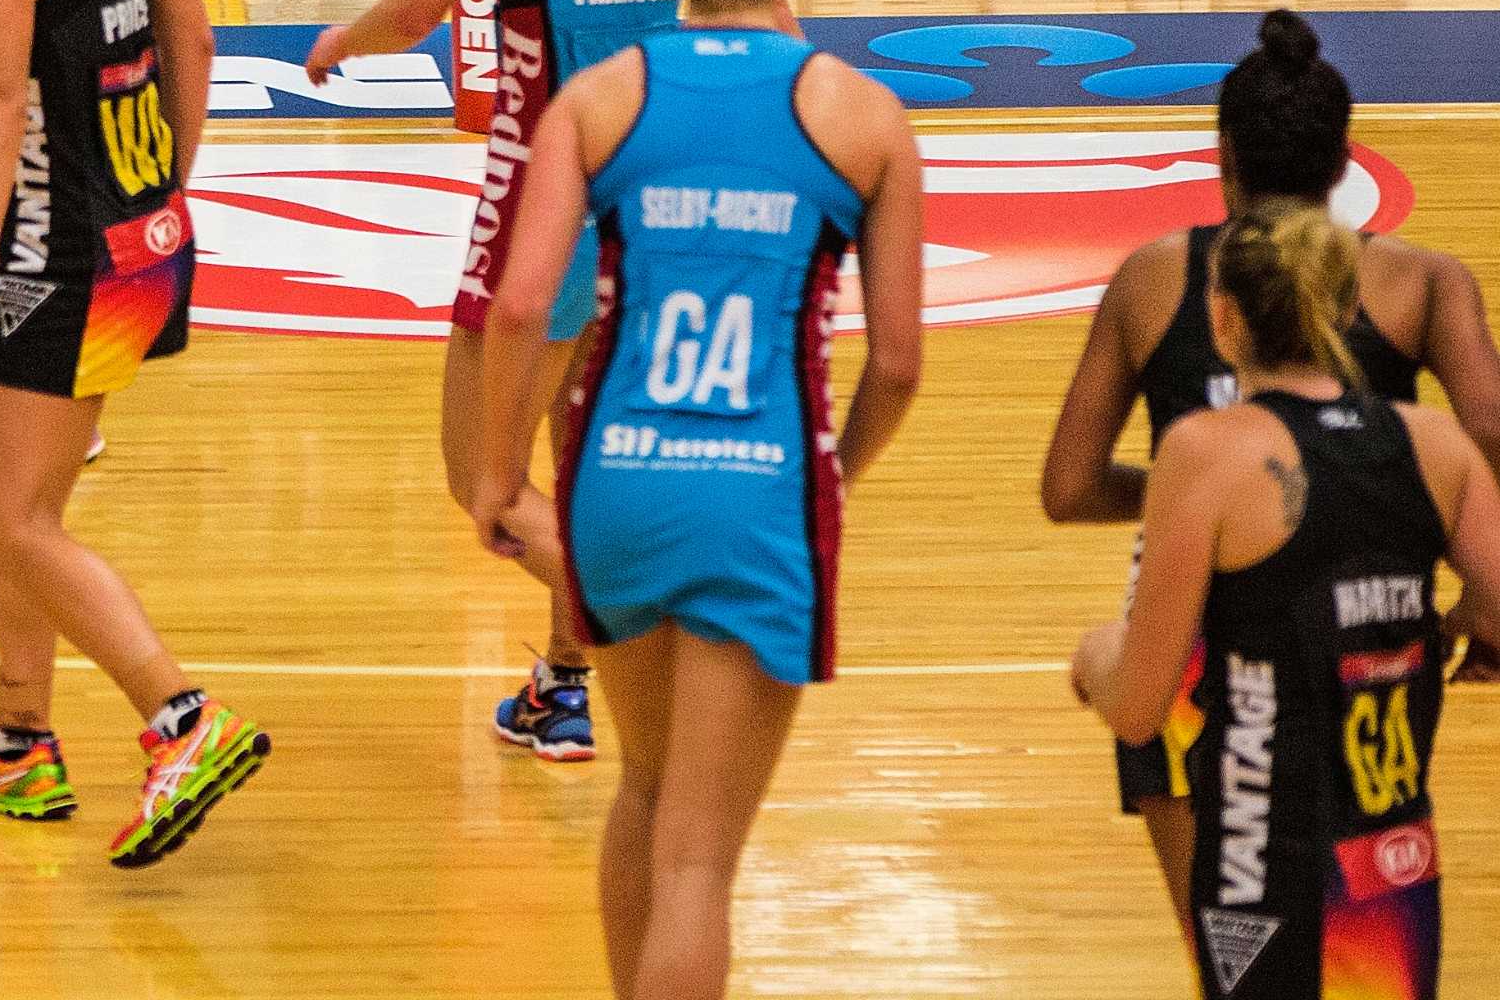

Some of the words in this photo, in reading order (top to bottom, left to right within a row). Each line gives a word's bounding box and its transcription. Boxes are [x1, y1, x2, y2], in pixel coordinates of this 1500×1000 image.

[645, 289, 754, 410] GA
[1217, 653, 1278, 906] VANTAGE
[1342, 683, 1419, 817] GA
